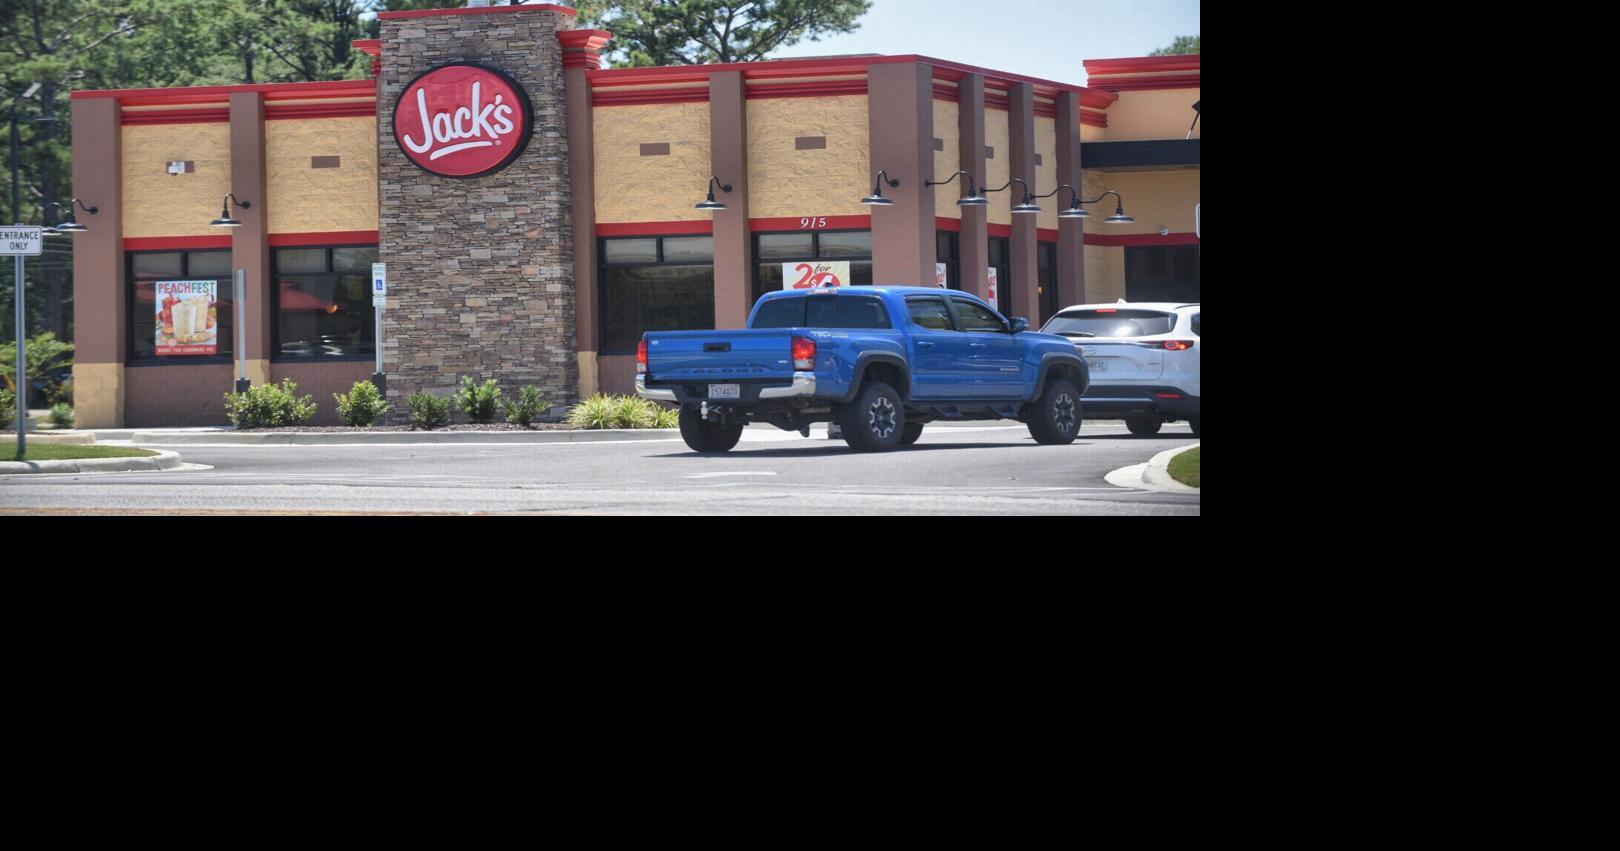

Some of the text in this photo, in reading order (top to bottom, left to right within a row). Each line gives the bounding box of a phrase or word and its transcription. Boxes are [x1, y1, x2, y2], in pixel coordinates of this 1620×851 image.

[403, 81, 514, 153] Jack's
[800, 217, 827, 229] 915
[0, 231, 39, 240] ENTRANCE
[9, 241, 29, 251] ONLY
[814, 264, 832, 274] for
[157, 282, 216, 294] PEACHFEST
[680, 367, 764, 375] TACOMA
